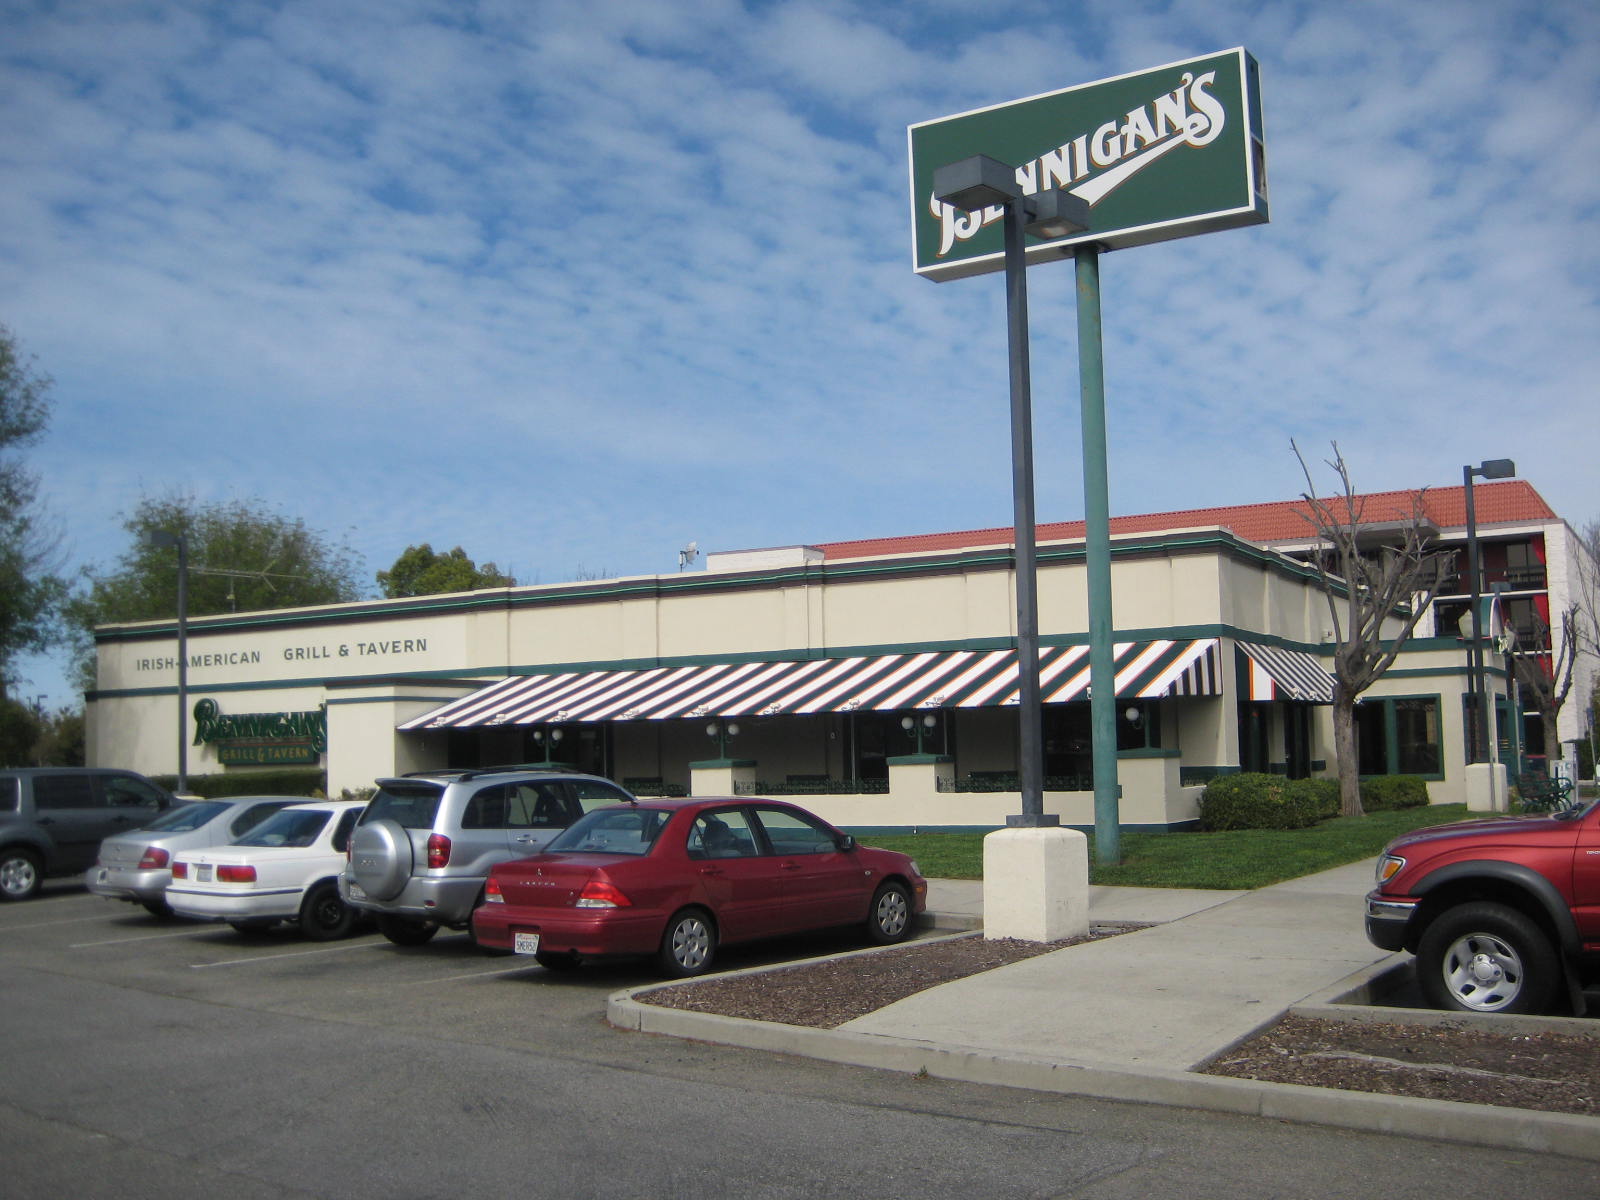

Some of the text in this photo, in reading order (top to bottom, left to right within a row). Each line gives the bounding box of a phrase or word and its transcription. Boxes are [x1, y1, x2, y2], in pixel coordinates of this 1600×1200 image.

[929, 70, 1226, 256] BNNIGAN'S
[284, 646, 330, 660] GRILL
[338, 644, 349, 657] &
[357, 639, 427, 656] TAVERN
[223, 747, 309, 762] GRILL & TAVERN
